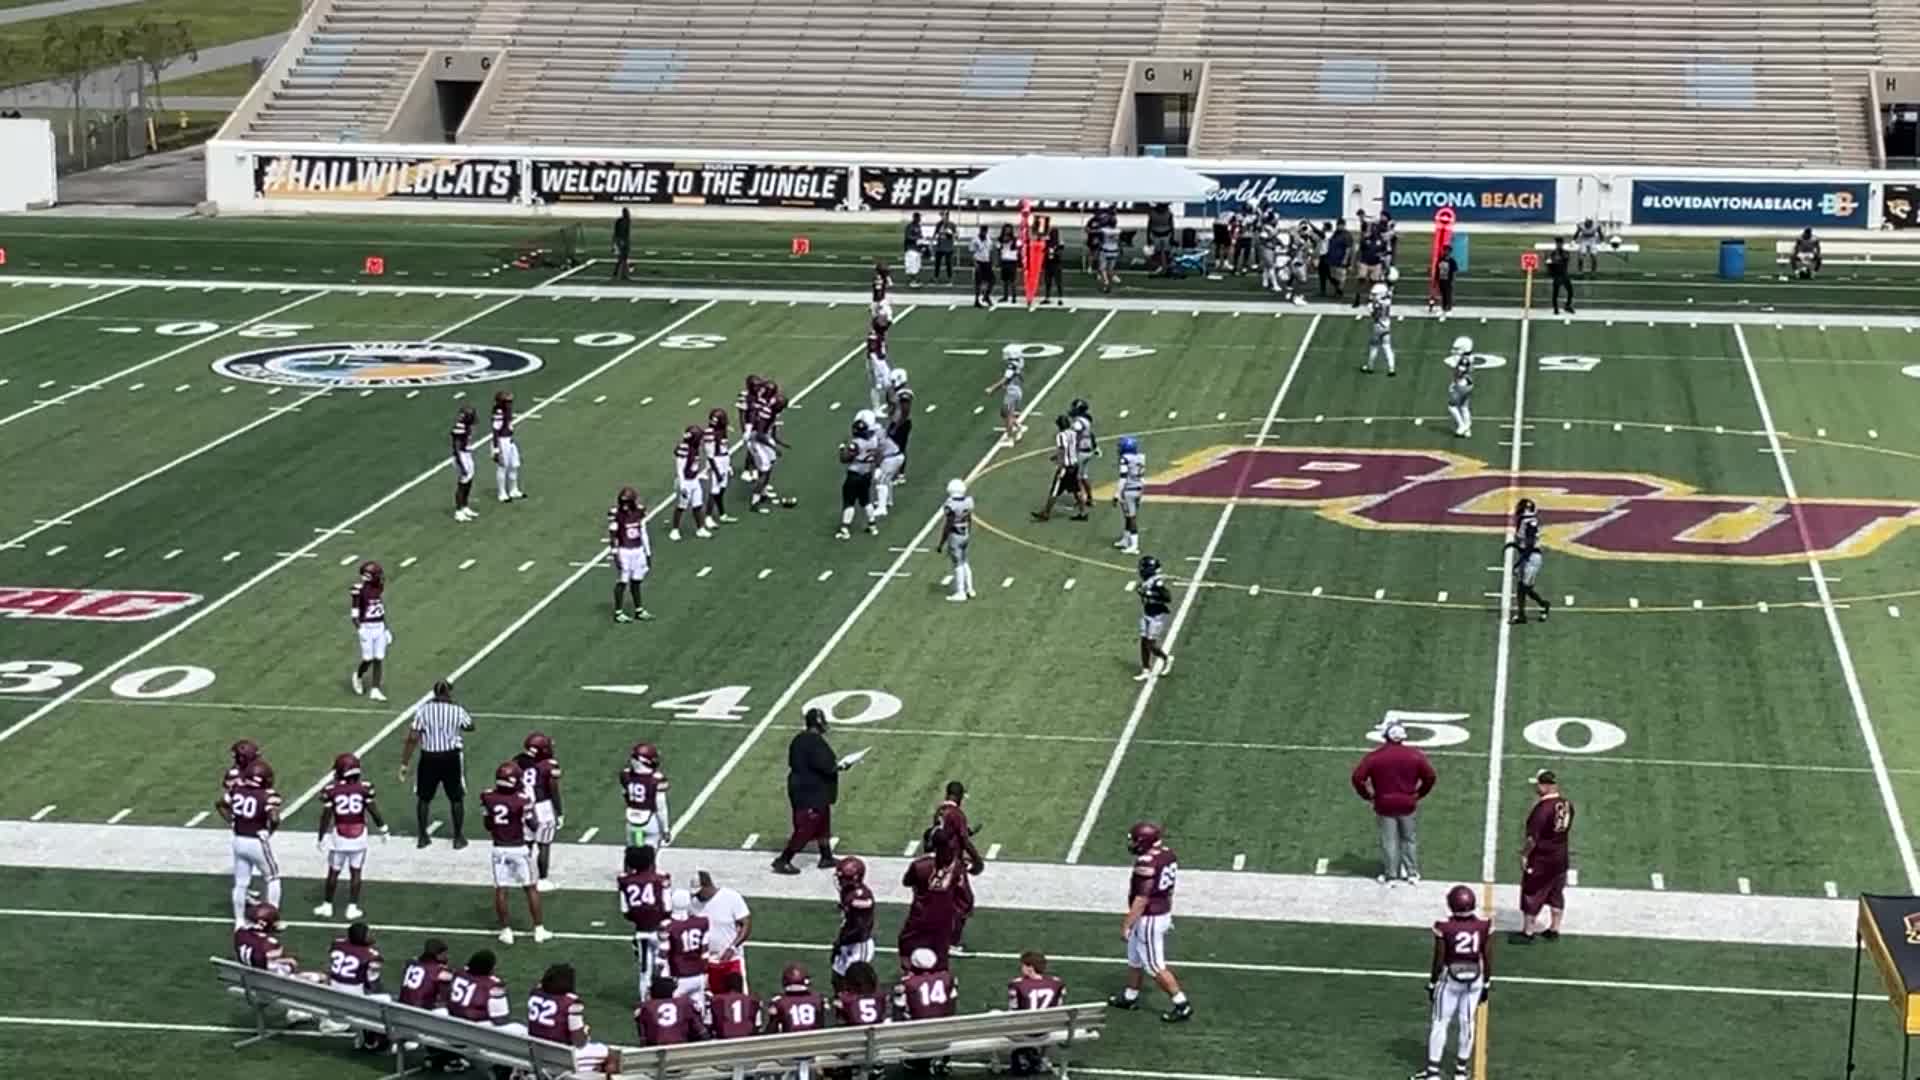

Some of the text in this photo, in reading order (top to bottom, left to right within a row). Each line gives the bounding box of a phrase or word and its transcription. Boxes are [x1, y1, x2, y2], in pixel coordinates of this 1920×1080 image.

[444, 56, 453, 69] F
[481, 56, 490, 71] G
[1144, 67, 1155, 82] G
[1183, 68, 1192, 81] H
[1886, 77, 1896, 91] H
[263, 157, 512, 196] #HAILWILDCATS
[541, 168, 838, 199] WELCOME TO THE JUNGLE
[1389, 191, 1543, 208] DAYTONA BEACH
[1642, 195, 1812, 211] #LOVEDAYTONABEACH
[1112, 443, 1920, 566] BCU
[335, 794, 363, 814] 26
[627, 782, 646, 803] 19
[232, 793, 257, 818] 20
[493, 804, 509, 825] 2
[627, 883, 655, 906] 24
[681, 928, 701, 952] 16
[1455, 931, 1479, 953] 21
[240, 943, 252, 966] 11
[331, 950, 359, 978] 32
[404, 964, 425, 989] 13
[451, 976, 476, 1006] 51
[920, 979, 947, 1005] 14
[1029, 988, 1053, 1010] 17
[528, 996, 557, 1026] 52
[656, 1003, 677, 1026] 3
[731, 1000, 742, 1023] 1
[789, 1003, 815, 1026] 18
[859, 999, 877, 1022] 5
